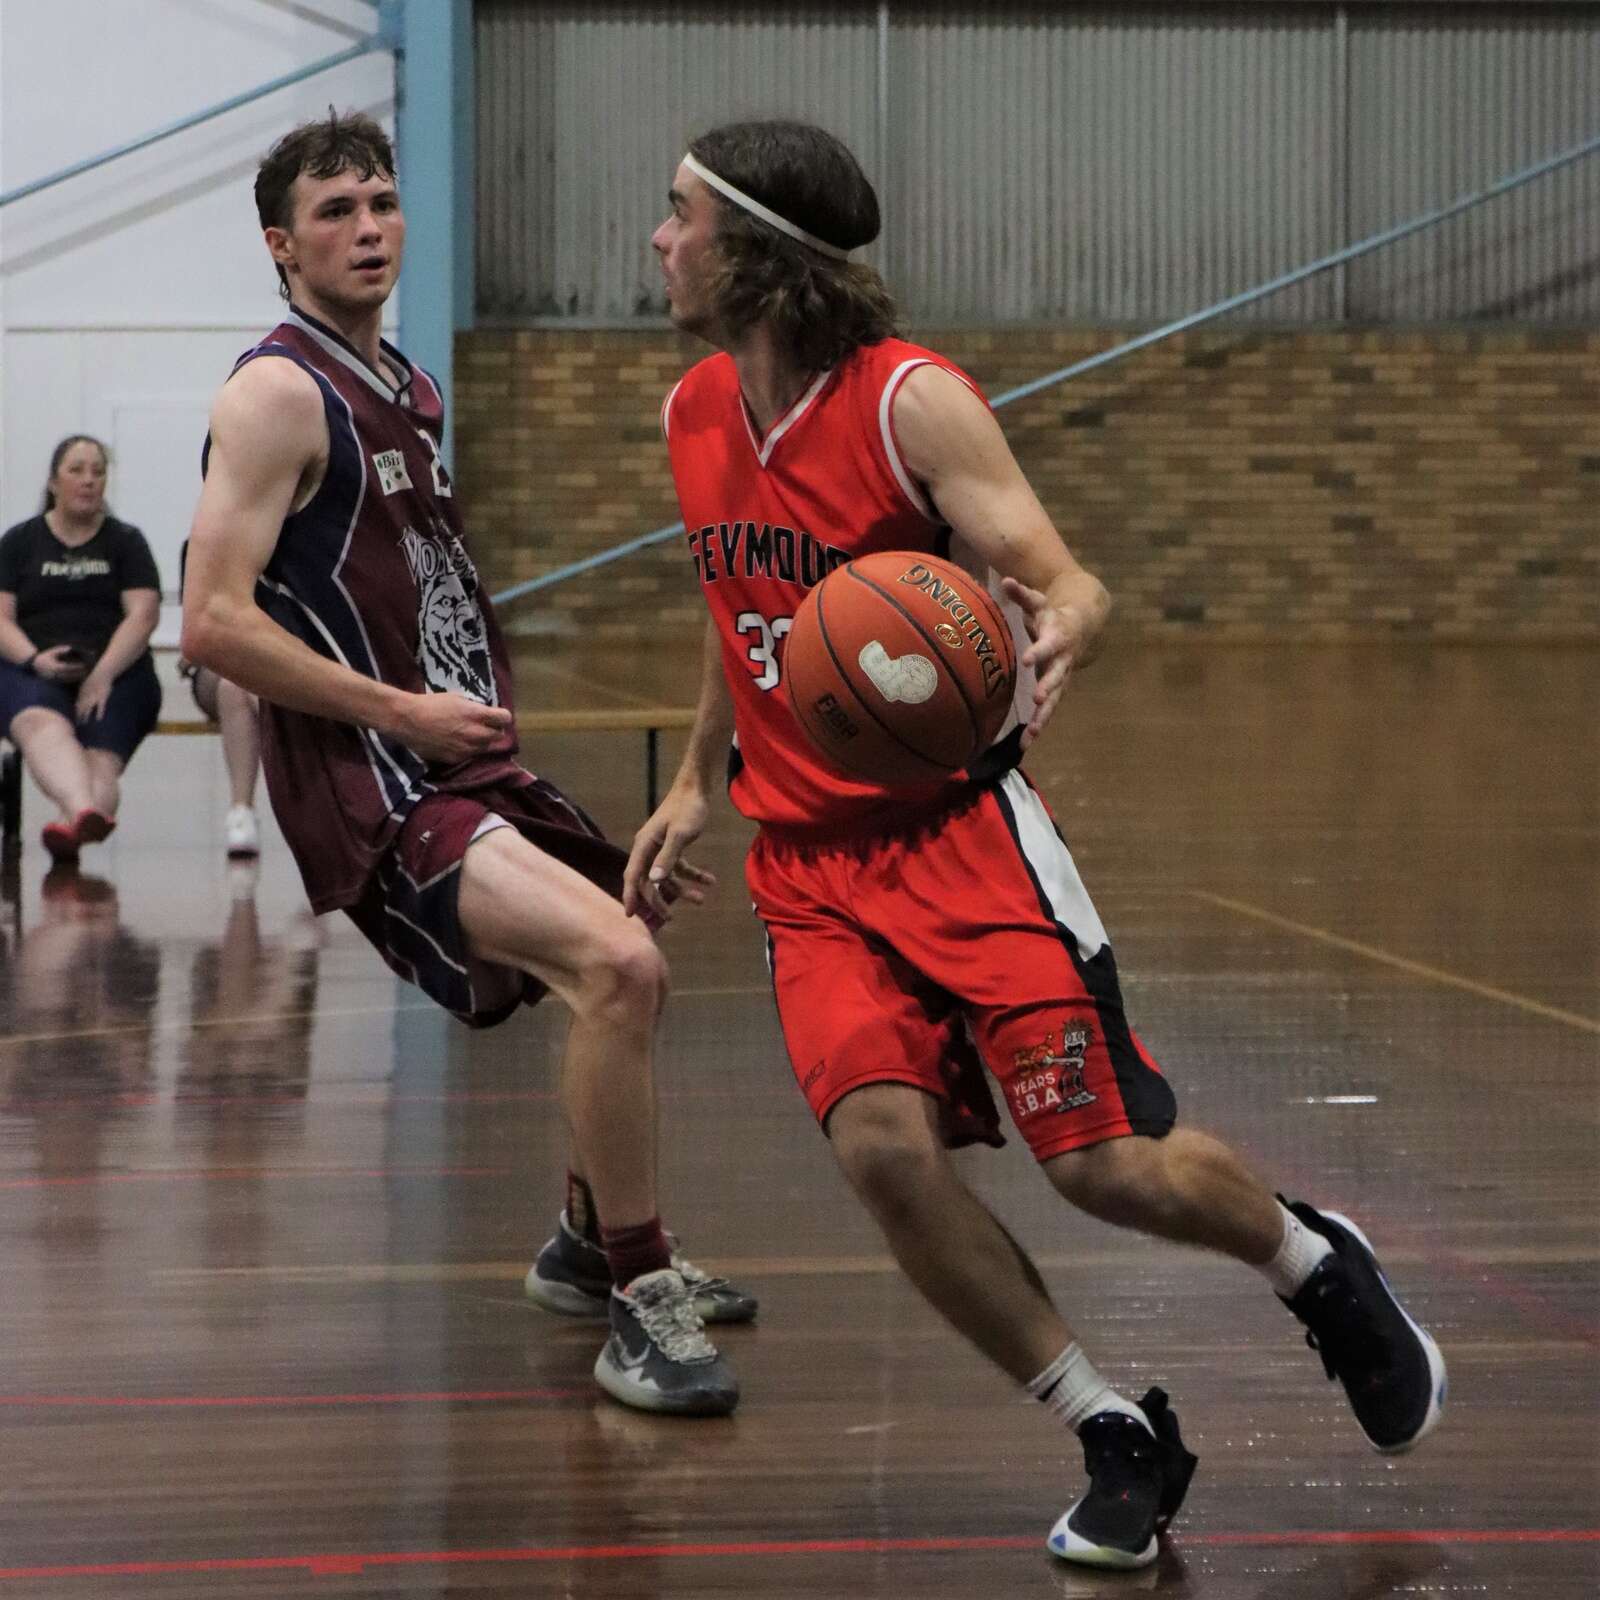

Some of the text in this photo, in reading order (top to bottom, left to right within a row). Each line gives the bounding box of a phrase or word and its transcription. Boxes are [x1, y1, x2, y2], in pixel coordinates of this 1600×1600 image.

[736, 610, 793, 692] 3
[898, 563, 1006, 699] SPALDING
[1013, 1072, 1056, 1096] YEARS
